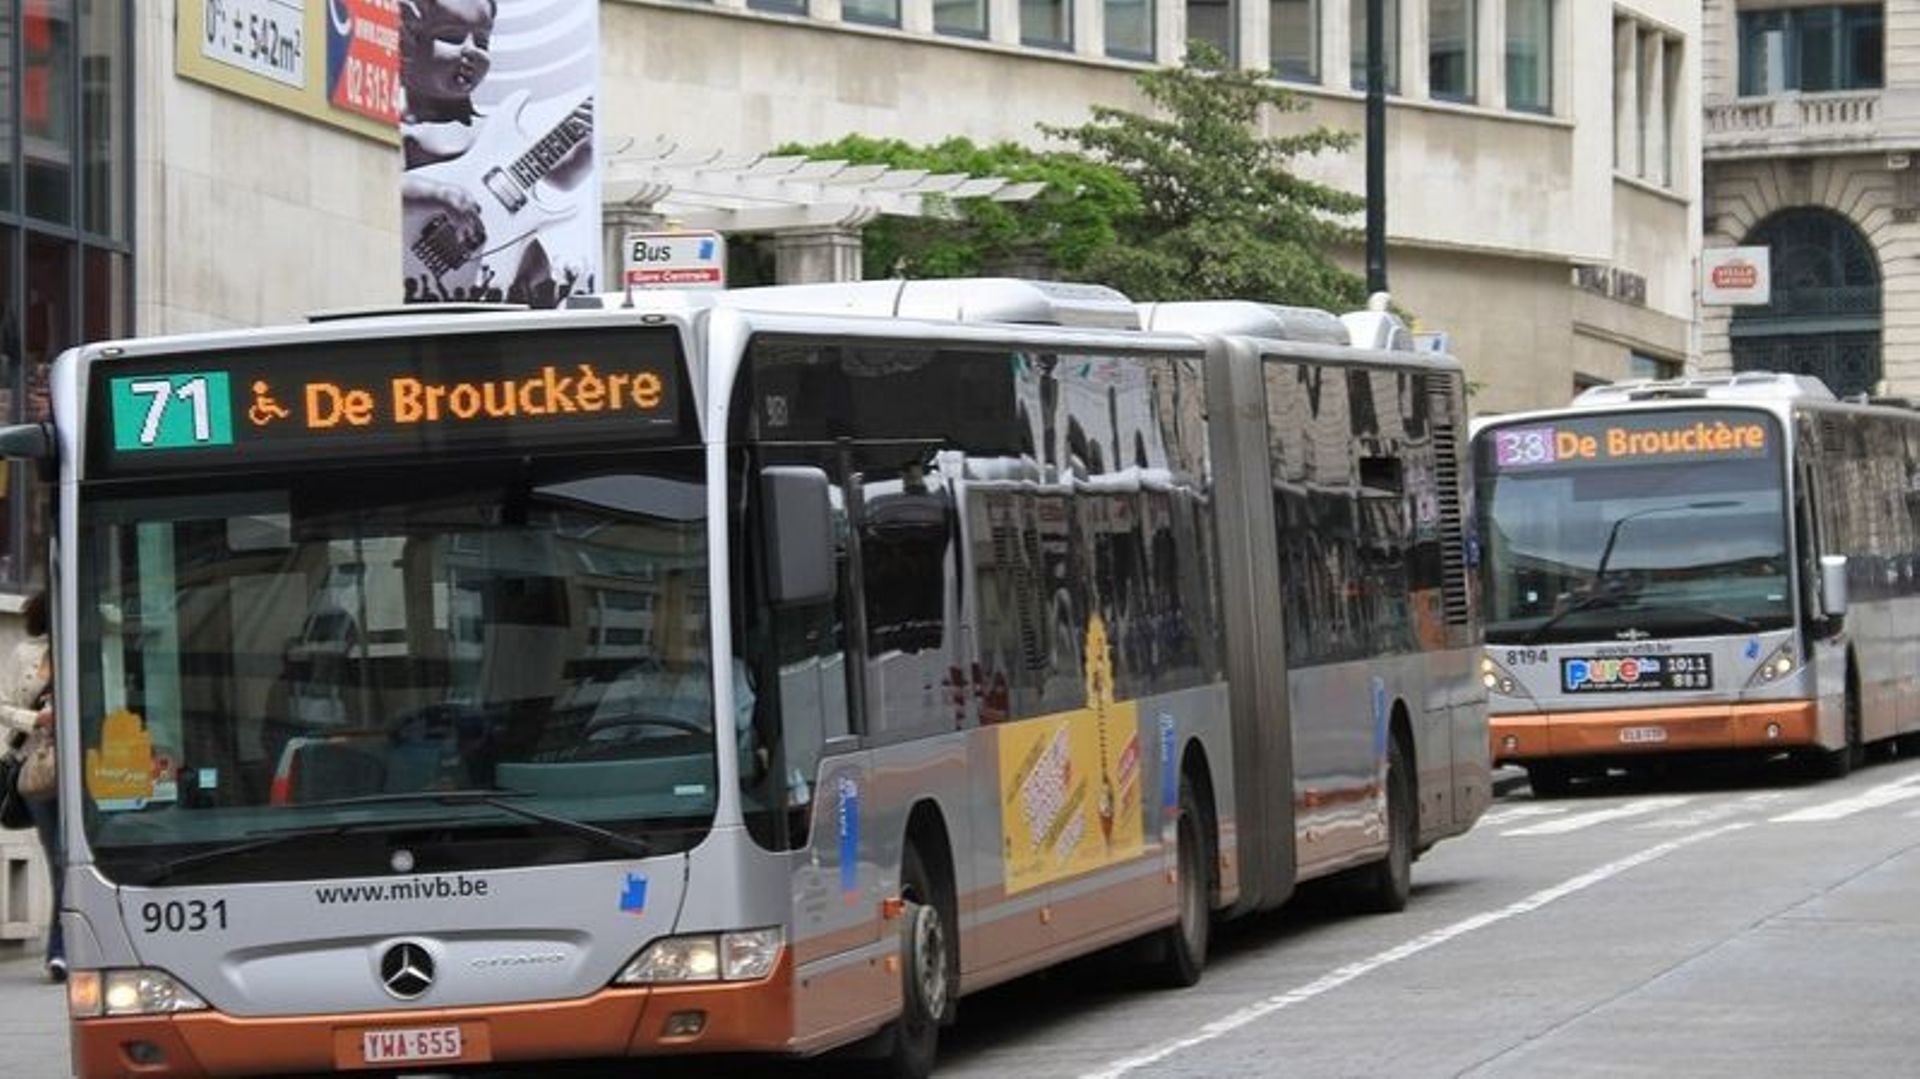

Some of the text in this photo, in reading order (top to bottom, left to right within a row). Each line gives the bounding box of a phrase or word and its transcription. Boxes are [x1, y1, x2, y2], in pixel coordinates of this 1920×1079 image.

[632, 241, 671, 262] Bus
[129, 377, 211, 445] 71
[306, 364, 661, 428] De Brouckère
[1507, 434, 1546, 463] 38
[1556, 422, 1764, 460] De Brouckère
[1507, 650, 1548, 665] 8194
[1566, 658, 1640, 690] pure
[316, 876, 488, 903] www.mivb.be
[143, 900, 228, 932] 9031
[368, 1029, 457, 1058] YWA-655
